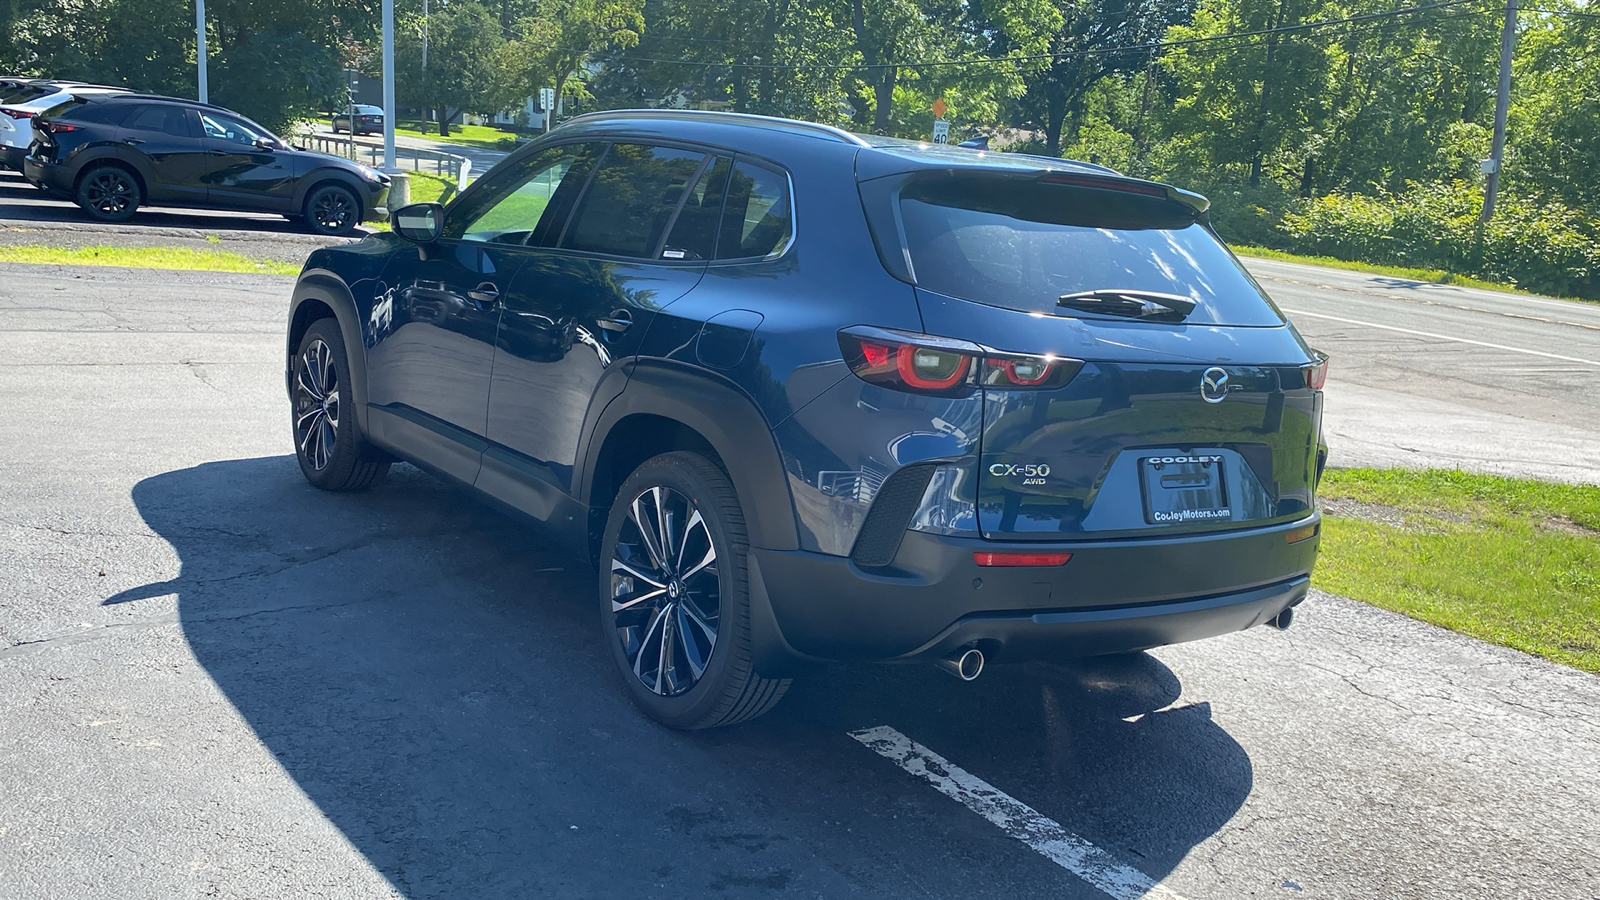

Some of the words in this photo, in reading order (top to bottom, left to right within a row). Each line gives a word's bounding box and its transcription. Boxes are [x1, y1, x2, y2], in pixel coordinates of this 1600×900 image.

[934, 134, 946, 144] 40
[1148, 455, 1221, 464] COOLEY
[989, 463, 1051, 477] CX-50
[1154, 509, 1231, 521] CooleyMotors.com
